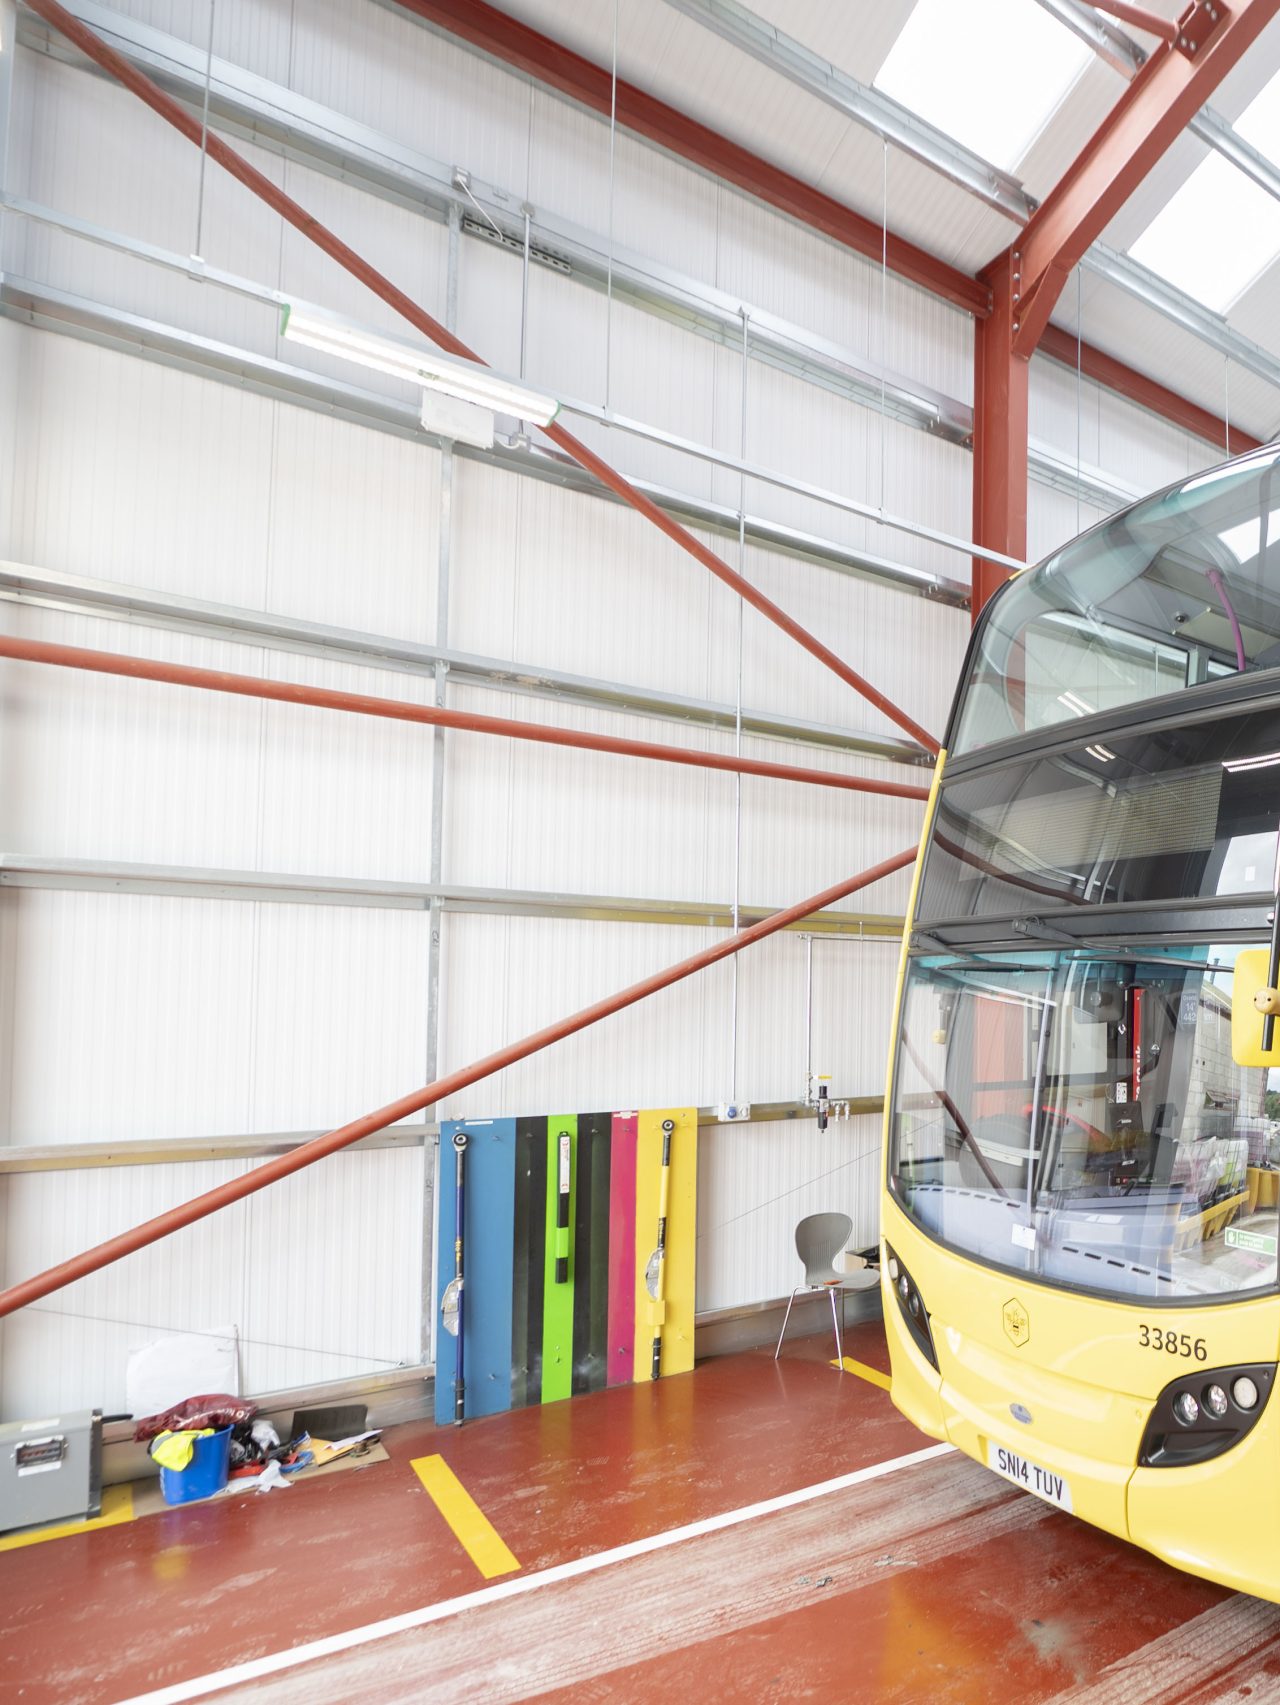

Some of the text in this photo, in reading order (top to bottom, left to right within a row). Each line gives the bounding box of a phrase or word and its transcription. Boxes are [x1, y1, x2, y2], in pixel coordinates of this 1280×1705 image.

[1138, 1324, 1208, 1362] 33856
[998, 1448, 1063, 1501] SN14 TUV
